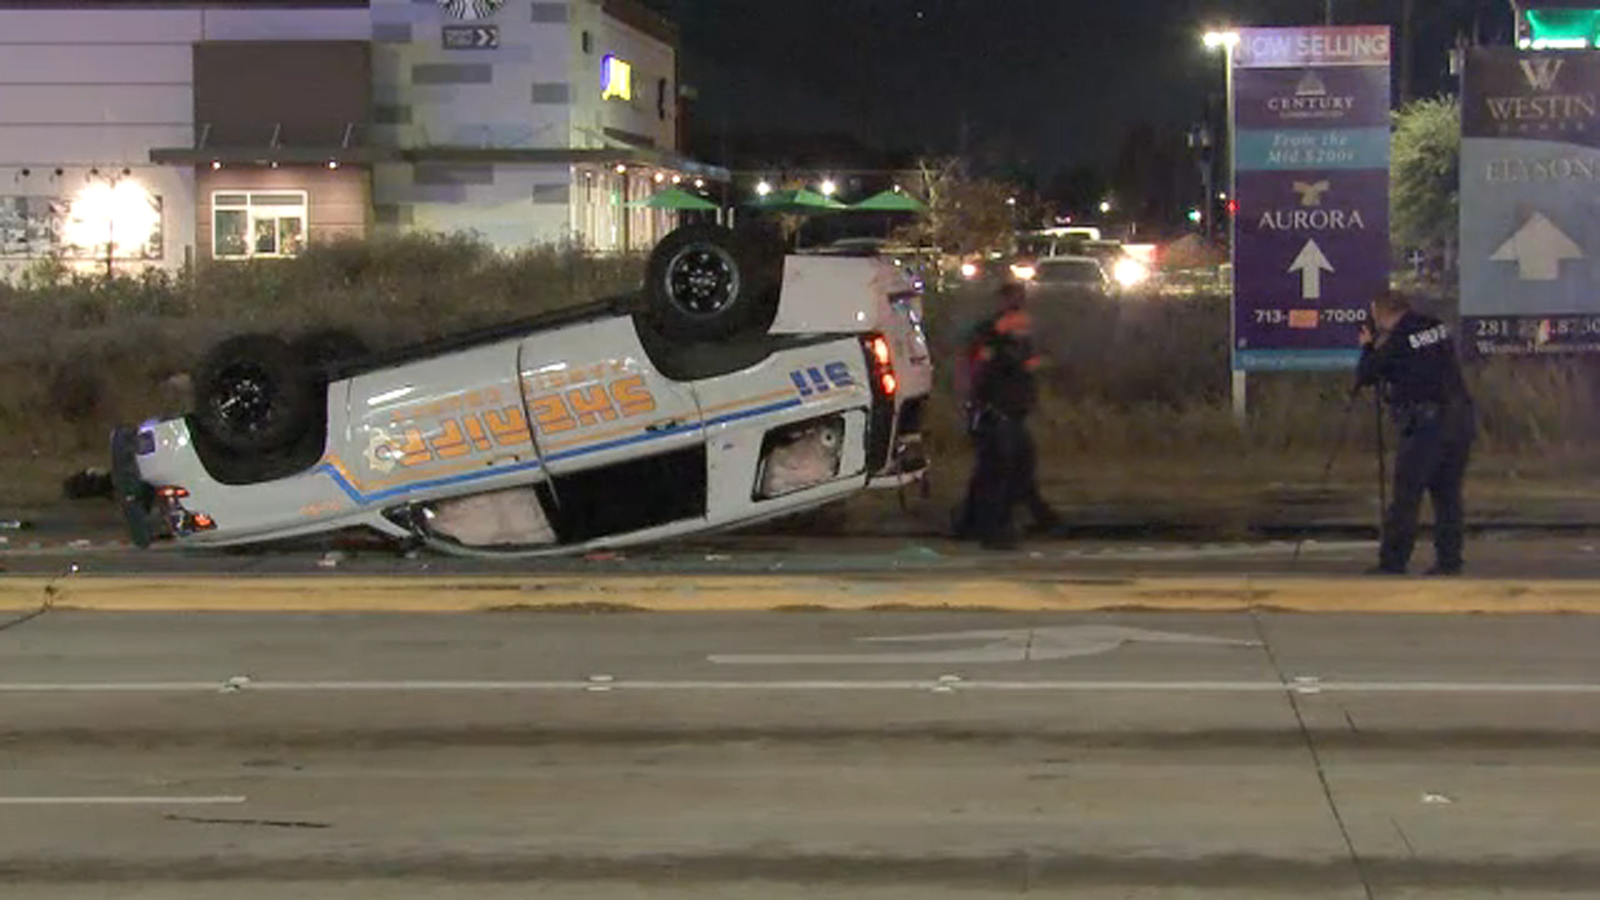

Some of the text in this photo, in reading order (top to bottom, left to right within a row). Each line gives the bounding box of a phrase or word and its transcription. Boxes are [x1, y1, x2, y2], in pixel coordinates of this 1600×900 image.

[1298, 34, 1388, 57] SELLING
[1266, 97, 1355, 110] CENTURY
[1486, 95, 1596, 119] WESTIN
[1258, 210, 1365, 230] AURORA
[400, 374, 656, 467] SHERIFF
